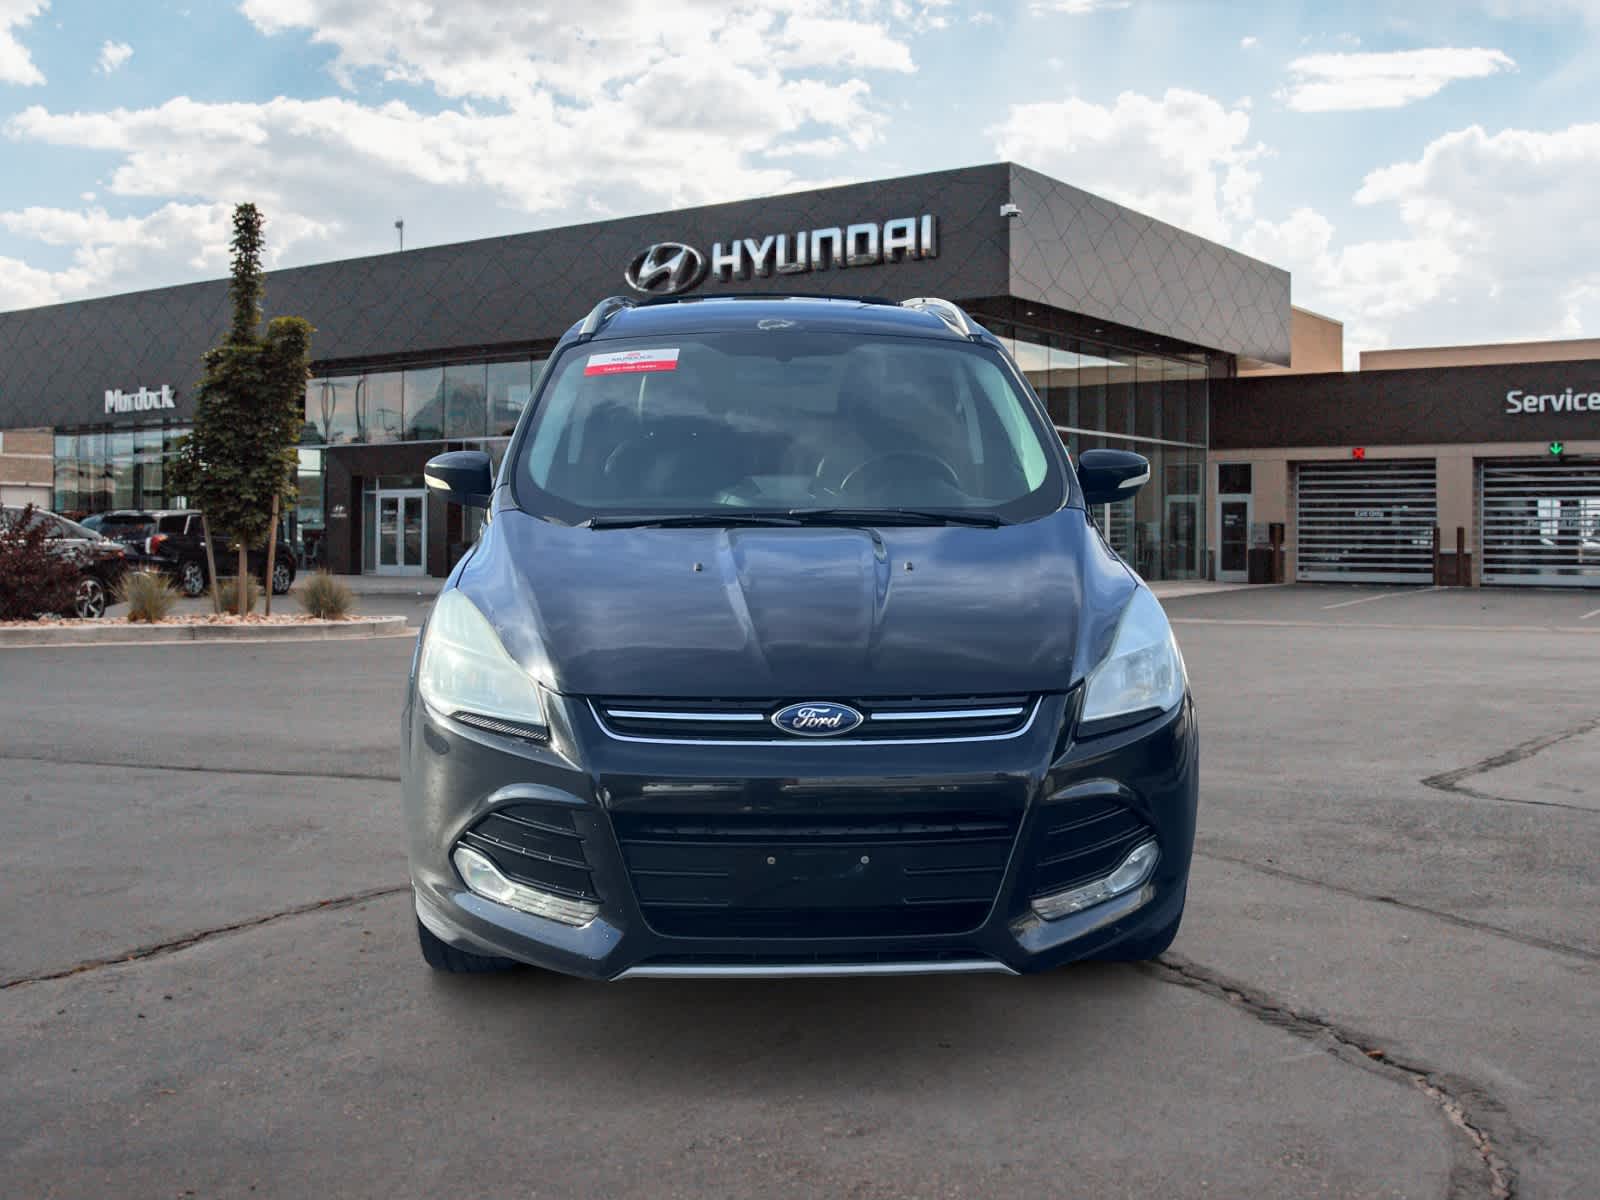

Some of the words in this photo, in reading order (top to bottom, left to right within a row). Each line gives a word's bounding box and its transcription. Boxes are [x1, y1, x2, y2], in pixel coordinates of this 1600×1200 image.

[711, 214, 937, 282] HYUNDAI
[104, 384, 176, 413] Murdock
[1506, 388, 1600, 413] Service
[792, 707, 842, 728] Ford
